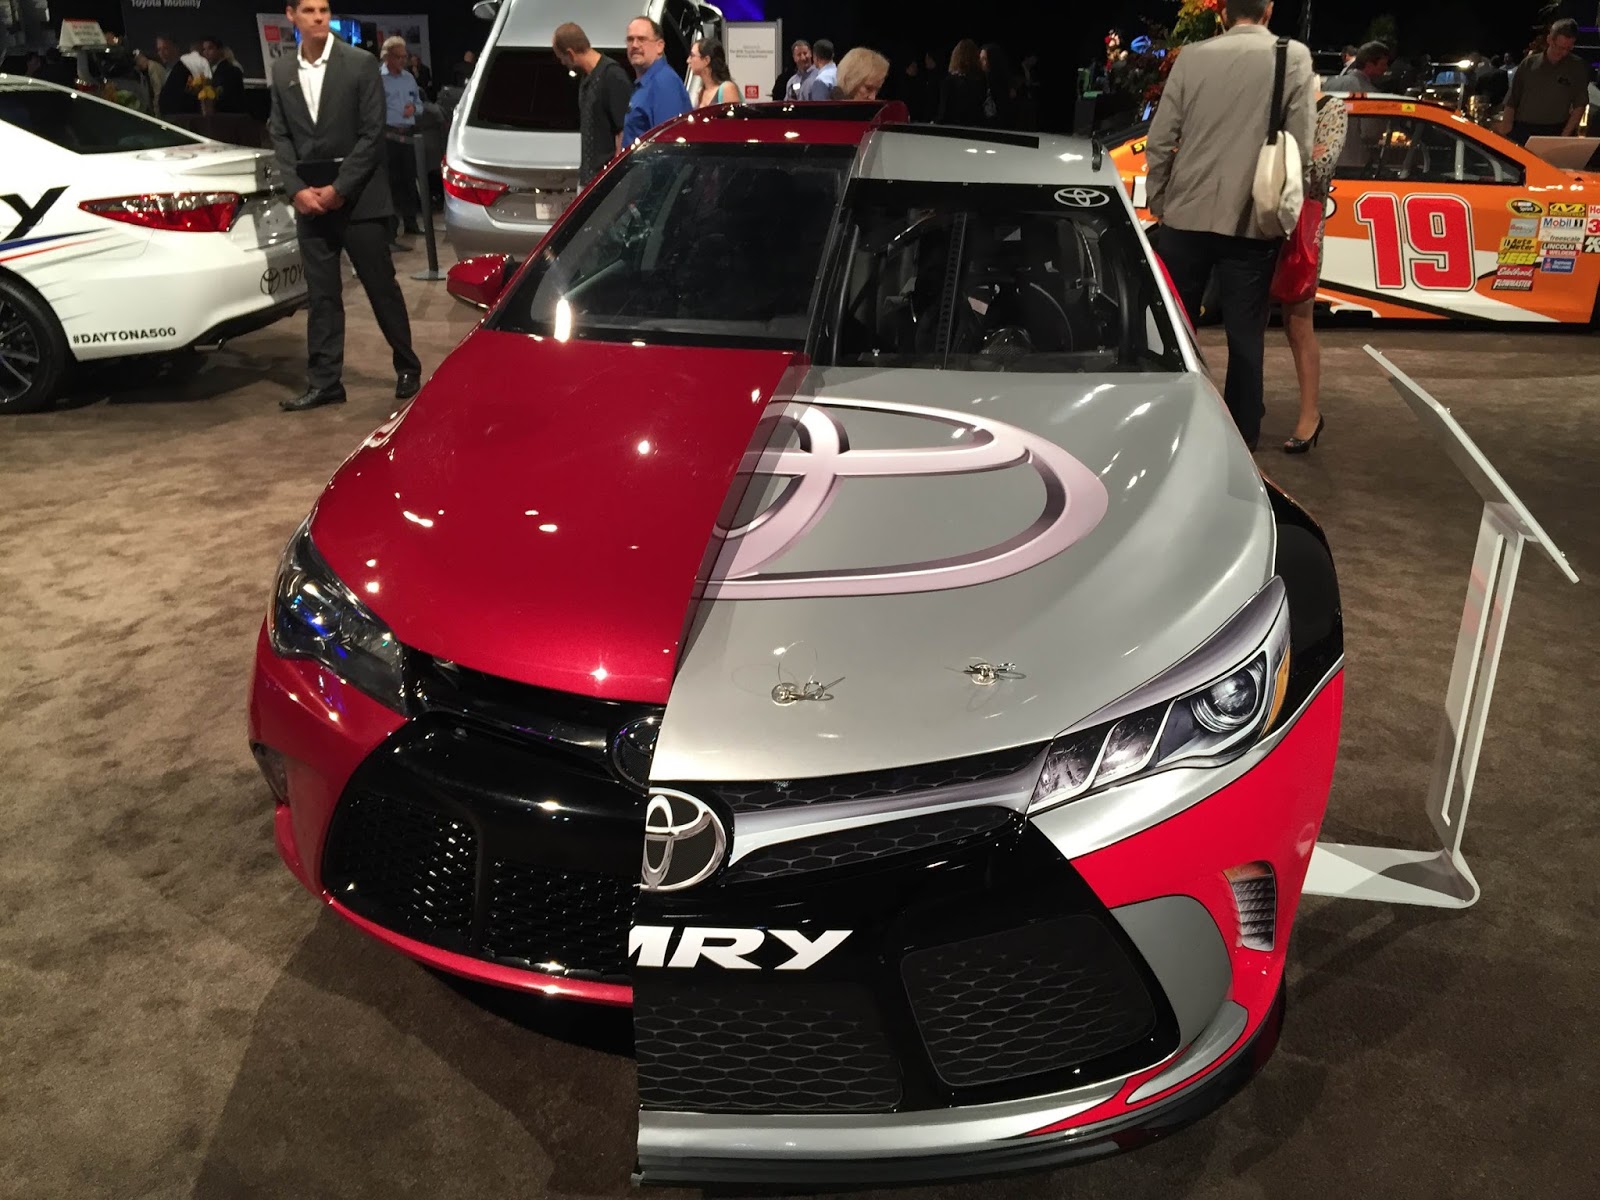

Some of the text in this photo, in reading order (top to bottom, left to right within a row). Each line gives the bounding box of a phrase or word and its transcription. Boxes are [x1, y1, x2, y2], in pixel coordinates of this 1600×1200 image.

[1543, 218, 1572, 227] Mobil
[1354, 191, 1476, 291] 19
[1493, 279, 1533, 289] FLOWMASTER
[73, 327, 176, 344] #DAYTONA500
